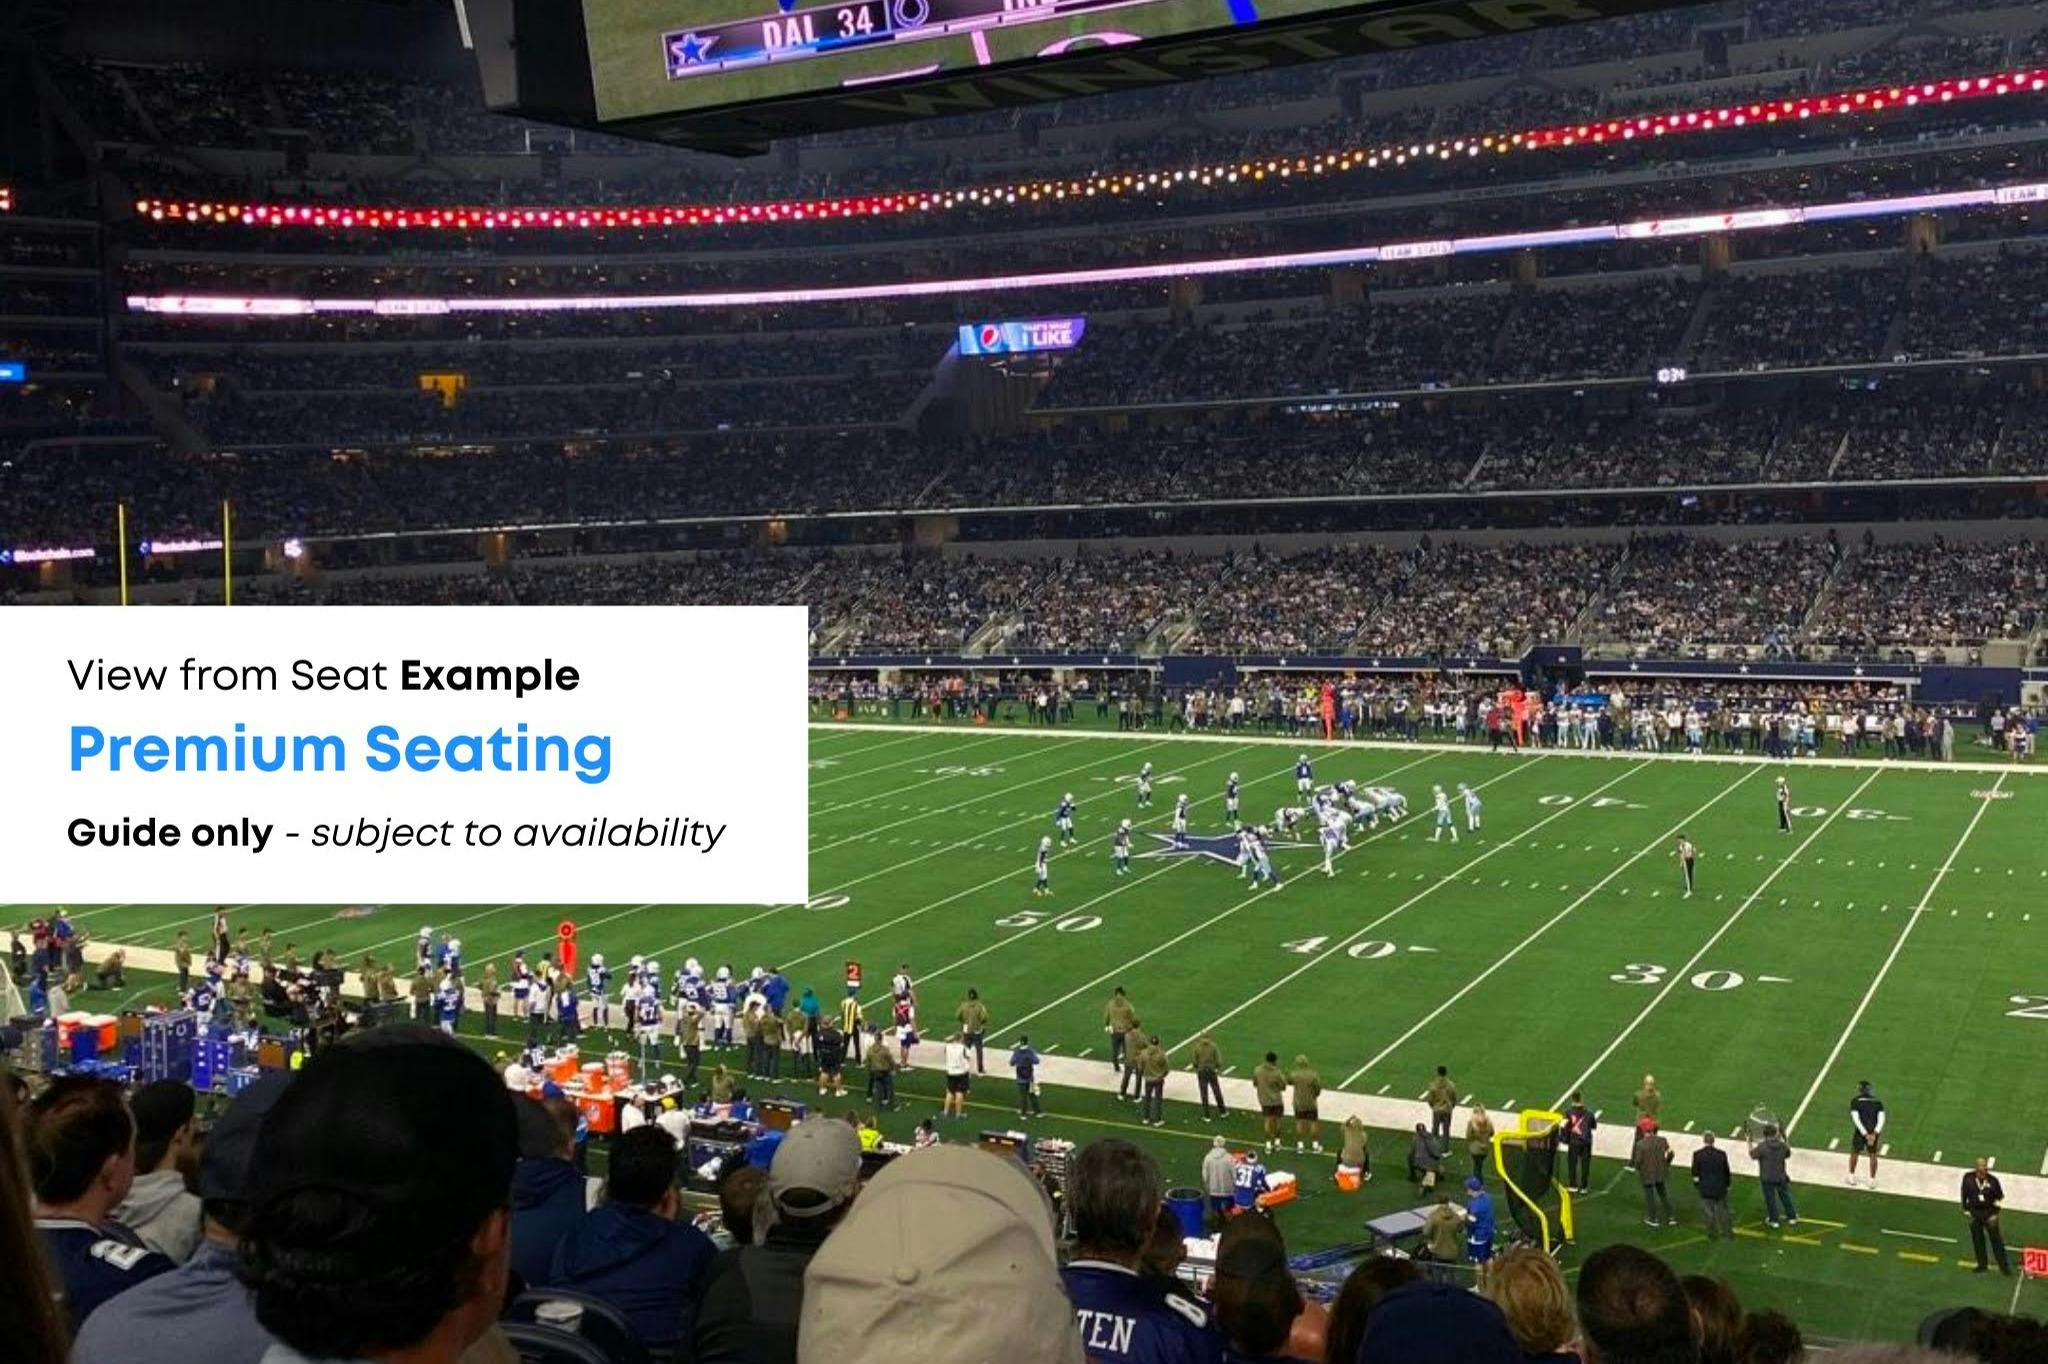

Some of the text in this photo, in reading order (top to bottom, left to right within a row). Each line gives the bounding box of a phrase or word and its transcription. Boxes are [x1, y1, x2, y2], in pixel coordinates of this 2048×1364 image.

[762, 5, 873, 49] DAL 34
[1032, 329, 1072, 346] LIKE
[995, 910, 1103, 931] 50
[1280, 935, 1396, 959] 40
[847, 964, 859, 980] 2
[1609, 963, 1744, 991] 30
[1235, 1165, 1254, 1188] 31
